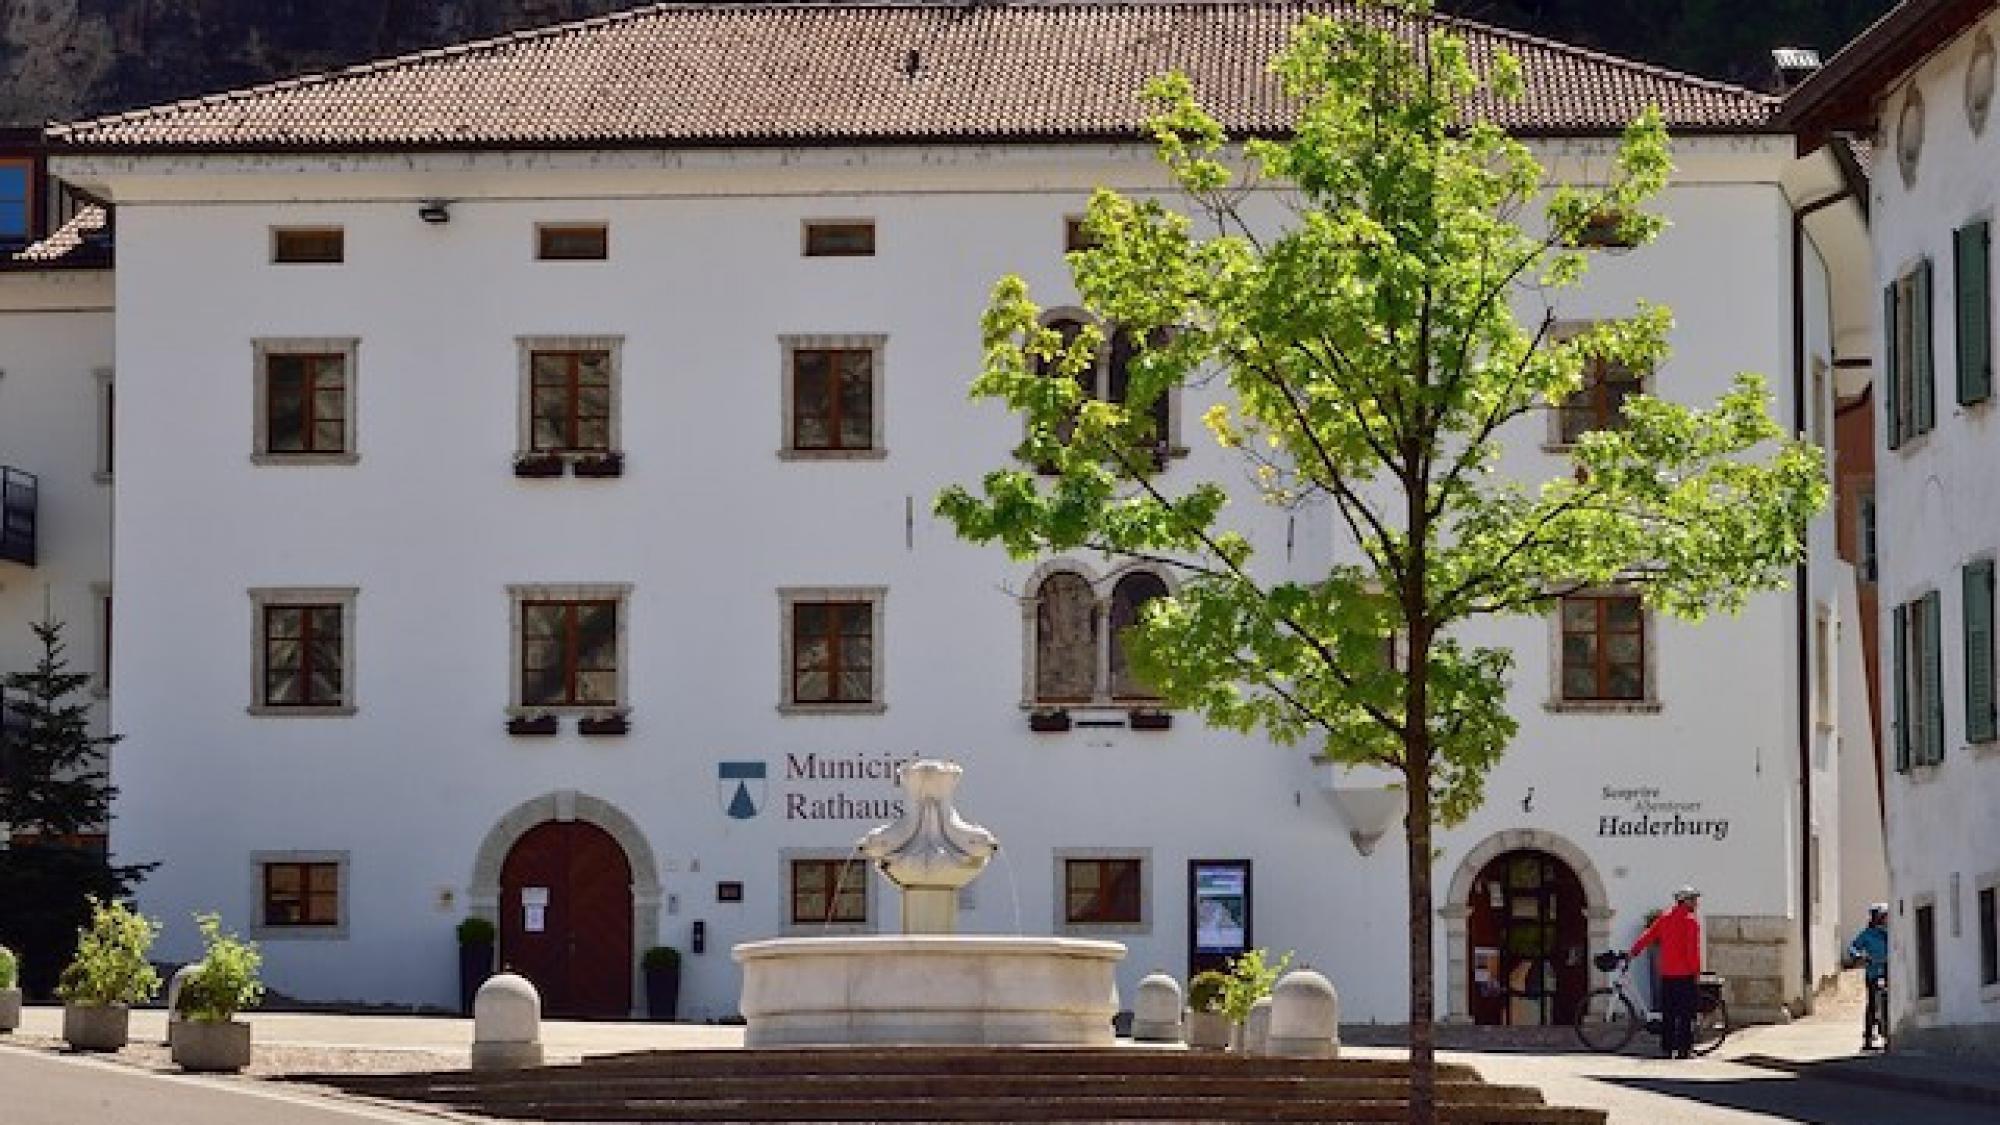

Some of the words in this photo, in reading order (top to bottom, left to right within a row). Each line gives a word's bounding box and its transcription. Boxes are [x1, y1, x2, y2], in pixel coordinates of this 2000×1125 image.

[786, 751, 919, 787] Municip
[786, 793, 905, 819] Rathaus
[1522, 787, 1535, 813] i
[1599, 815, 1729, 841] Haderburg
